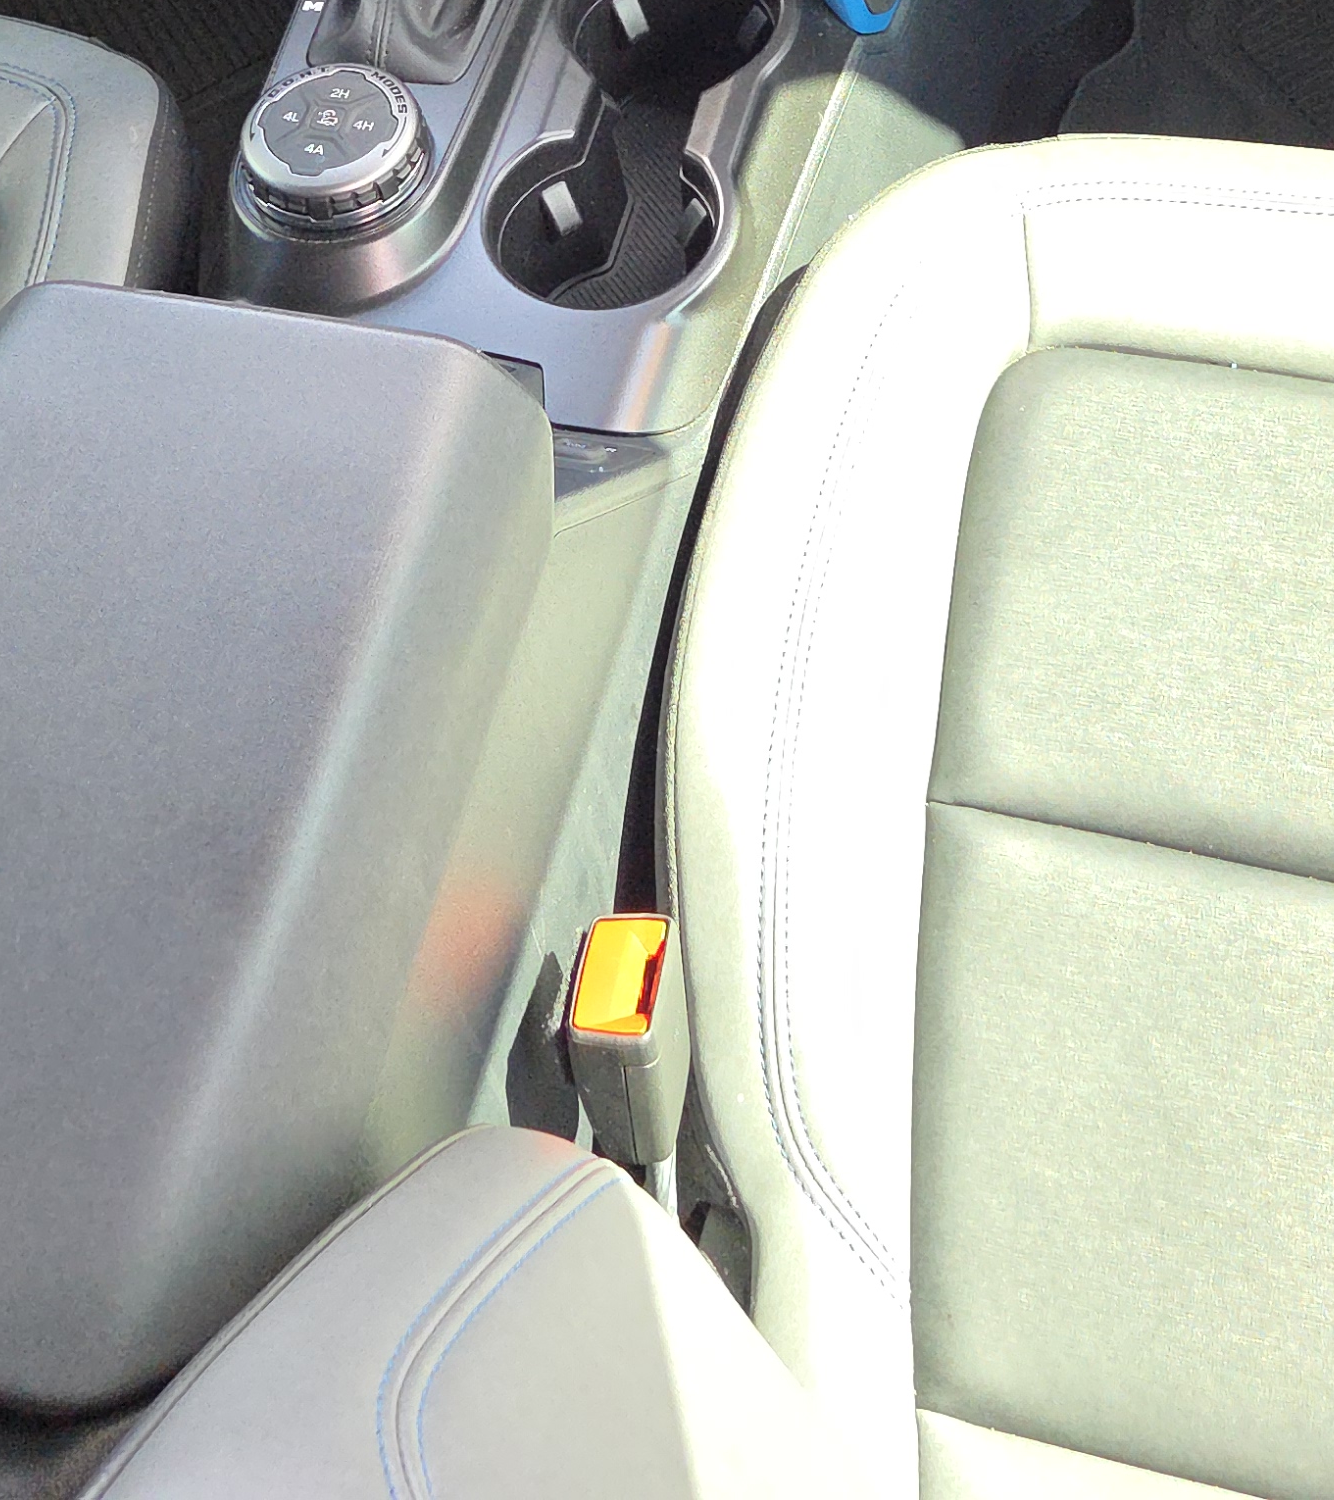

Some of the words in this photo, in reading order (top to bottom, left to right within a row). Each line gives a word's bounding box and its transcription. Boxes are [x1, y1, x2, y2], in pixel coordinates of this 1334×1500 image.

[301, 0, 325, 12] M
[329, 87, 351, 99] 2H
[371, 71, 408, 115] MODES
[282, 111, 299, 124] 4L
[352, 119, 375, 132] 4H
[303, 143, 325, 156] 4A
